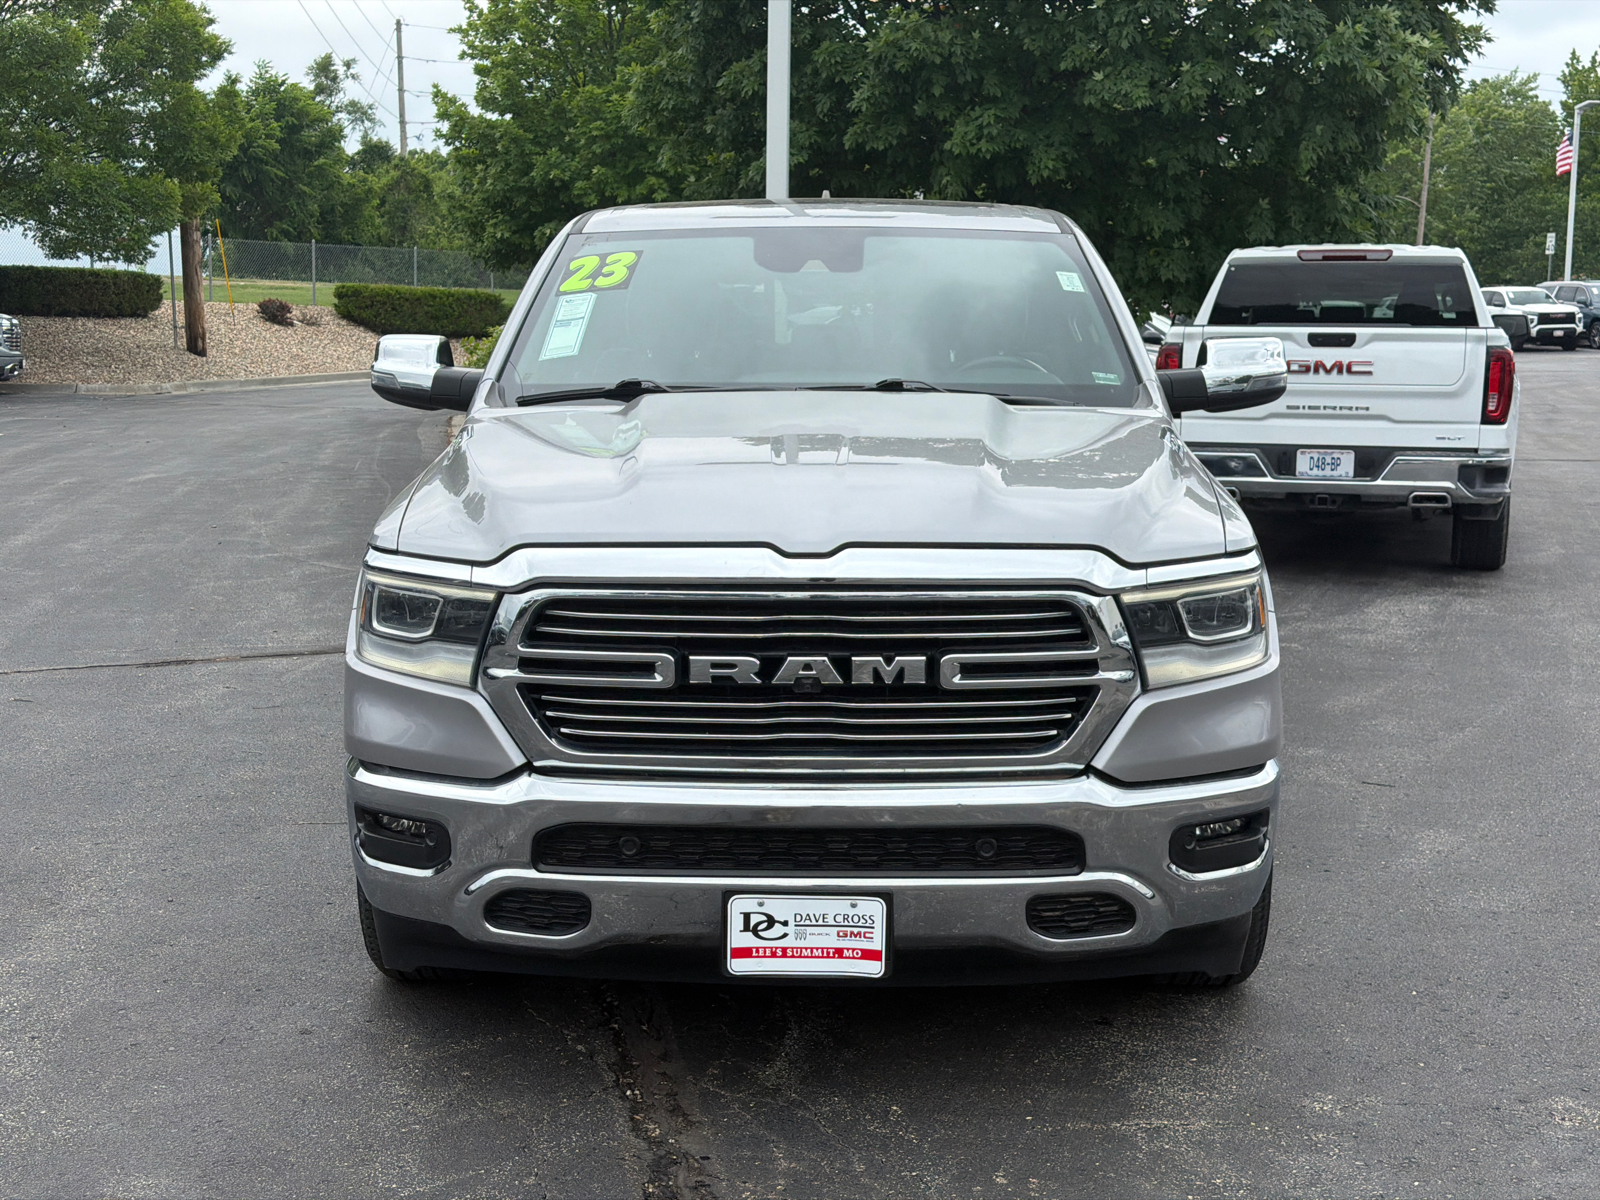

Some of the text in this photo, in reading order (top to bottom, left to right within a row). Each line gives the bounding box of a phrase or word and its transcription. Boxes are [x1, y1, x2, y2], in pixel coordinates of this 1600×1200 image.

[559, 251, 638, 292] 23
[1286, 359, 1374, 375] GMC
[689, 655, 927, 684] RAM
[794, 912, 875, 925] DAVE CROSS
[836, 929, 874, 940] GMC
[751, 948, 862, 959] LEE'S SUMMIT, MO
